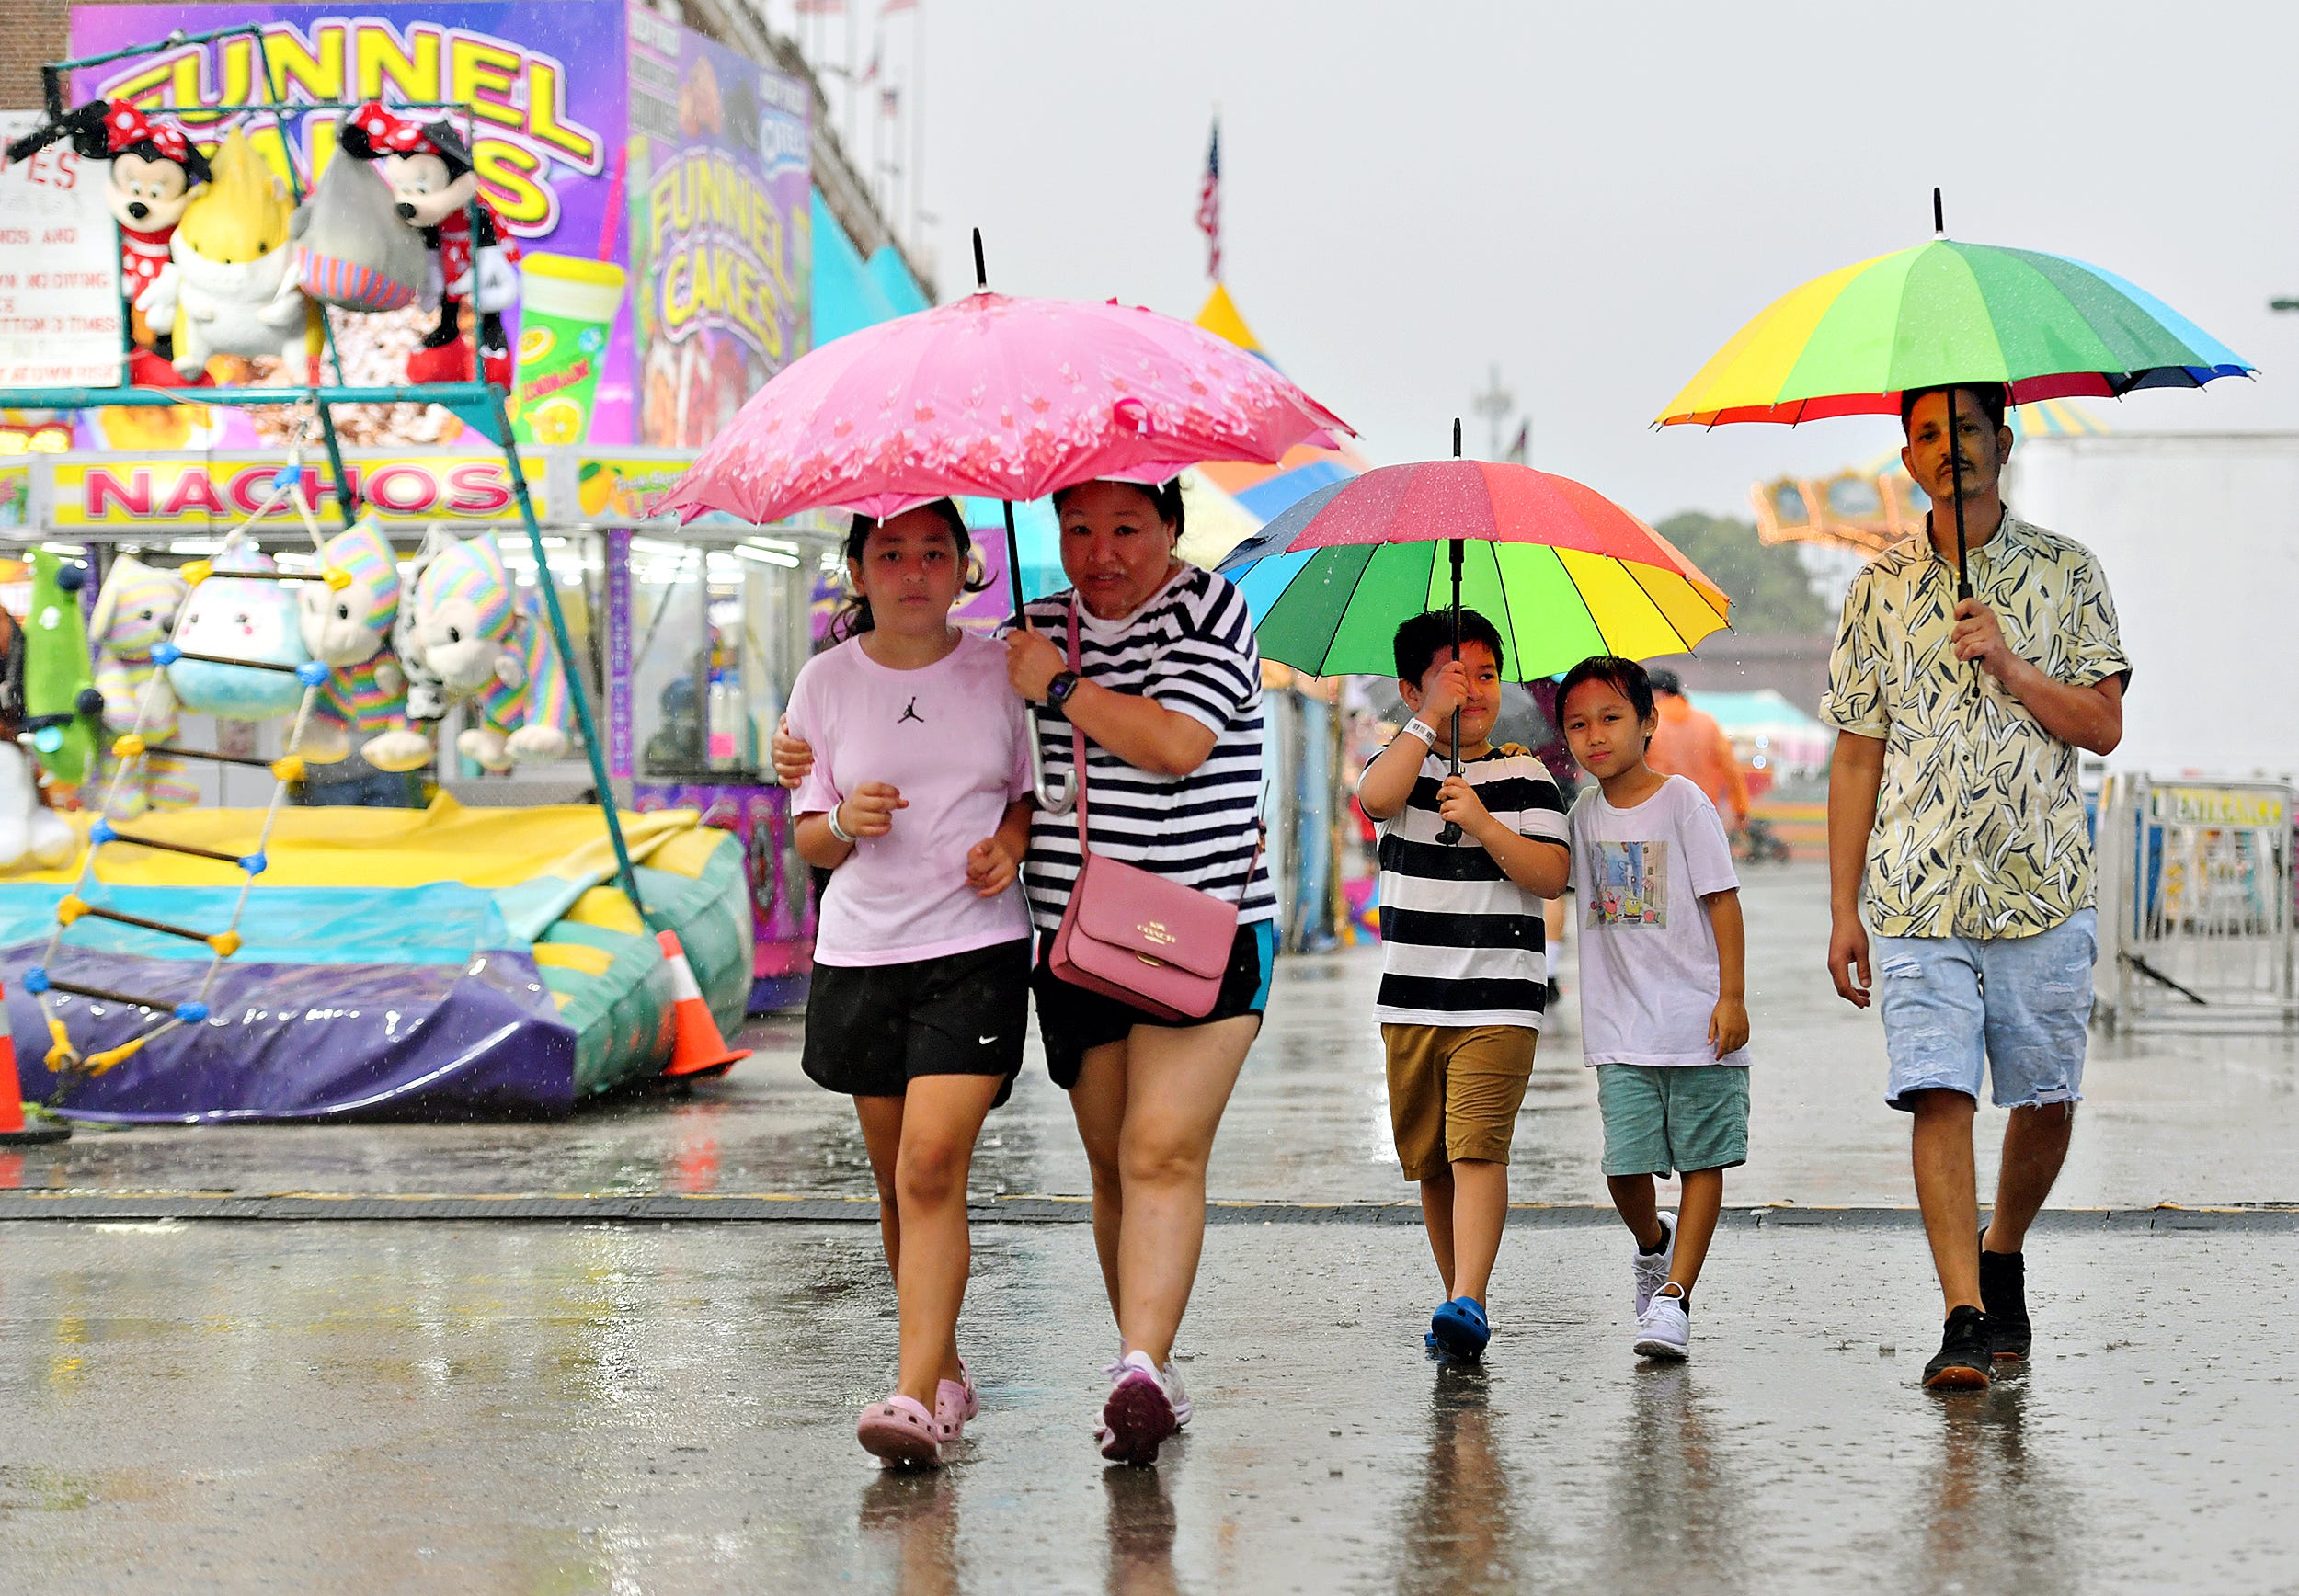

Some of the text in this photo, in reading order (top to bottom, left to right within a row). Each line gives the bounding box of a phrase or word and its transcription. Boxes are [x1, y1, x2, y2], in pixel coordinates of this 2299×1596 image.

[649, 154, 796, 303] FUNNEL
[663, 244, 782, 358] CAKES
[85, 464, 515, 519] NACHOS
